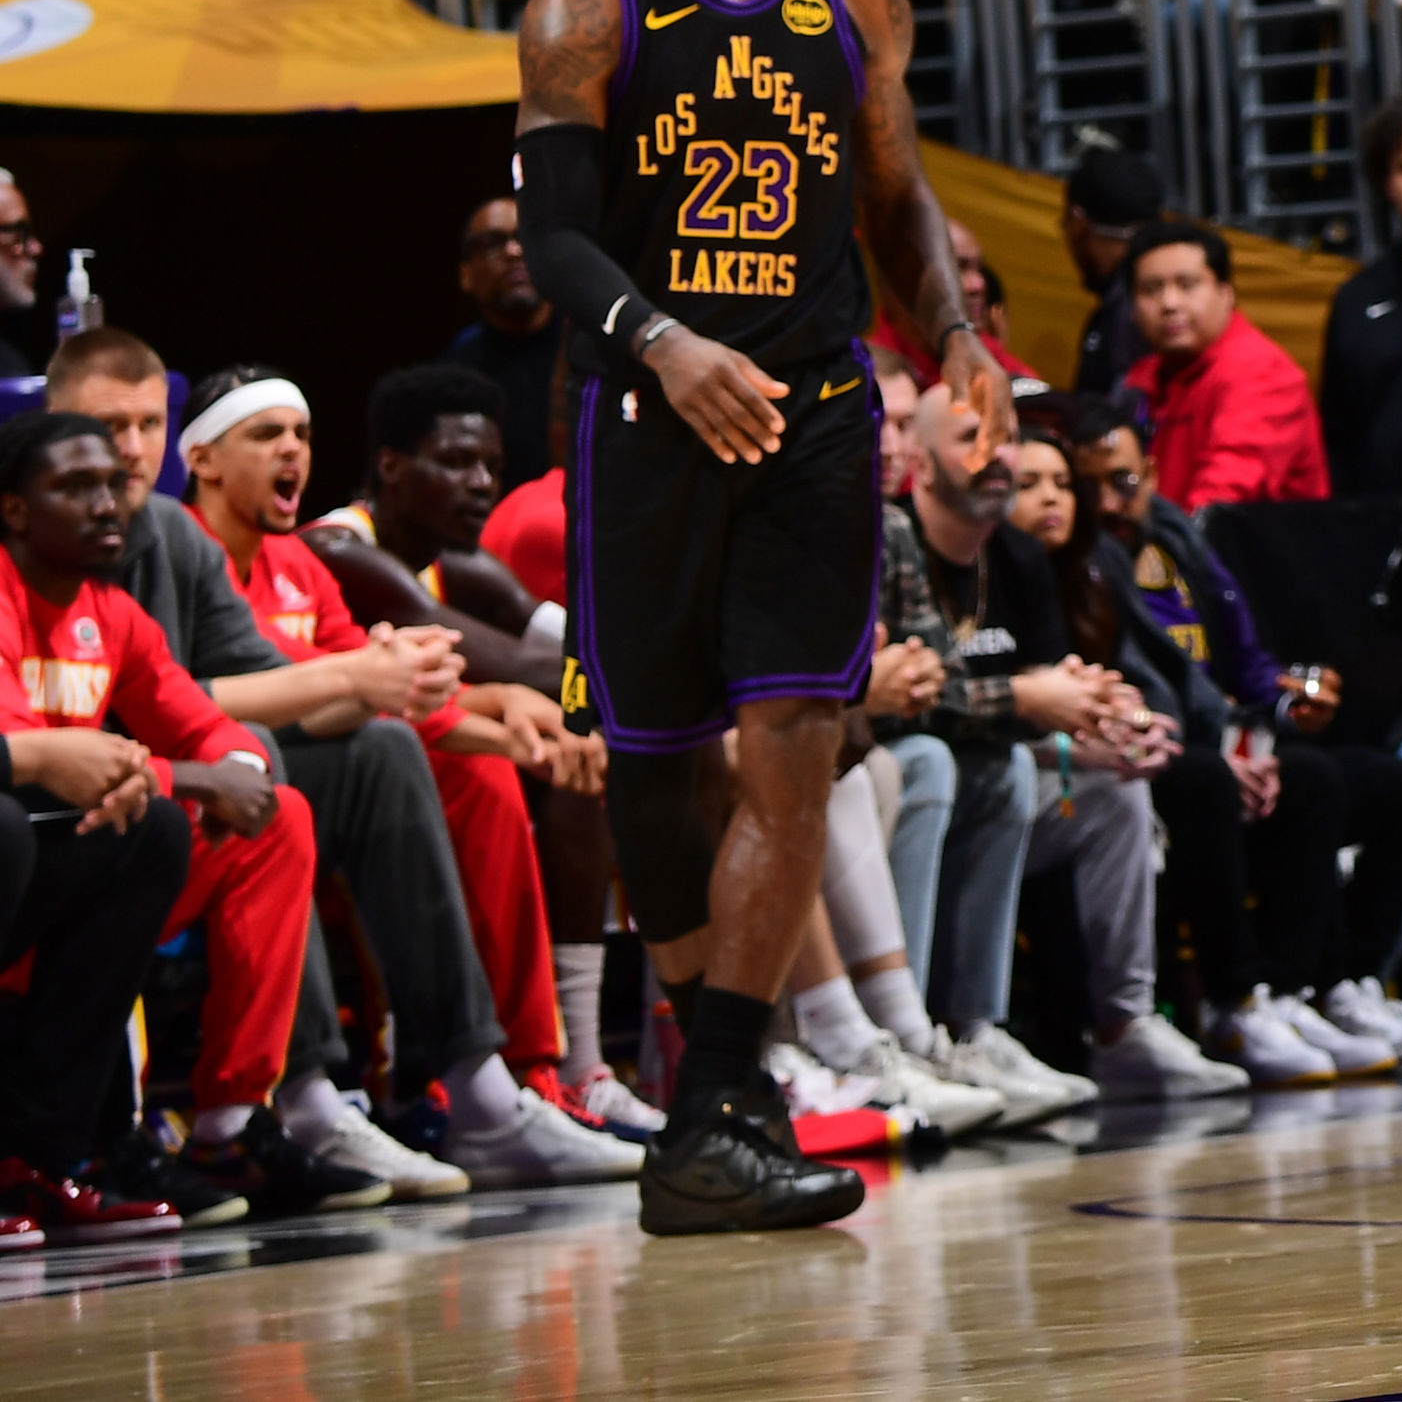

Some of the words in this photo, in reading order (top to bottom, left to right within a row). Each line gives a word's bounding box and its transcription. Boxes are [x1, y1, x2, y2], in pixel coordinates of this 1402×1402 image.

[636, 93, 697, 175] LOS
[713, 35, 838, 175] ANGELES
[677, 140, 799, 240] 23
[668, 249, 797, 297] LAKERS
